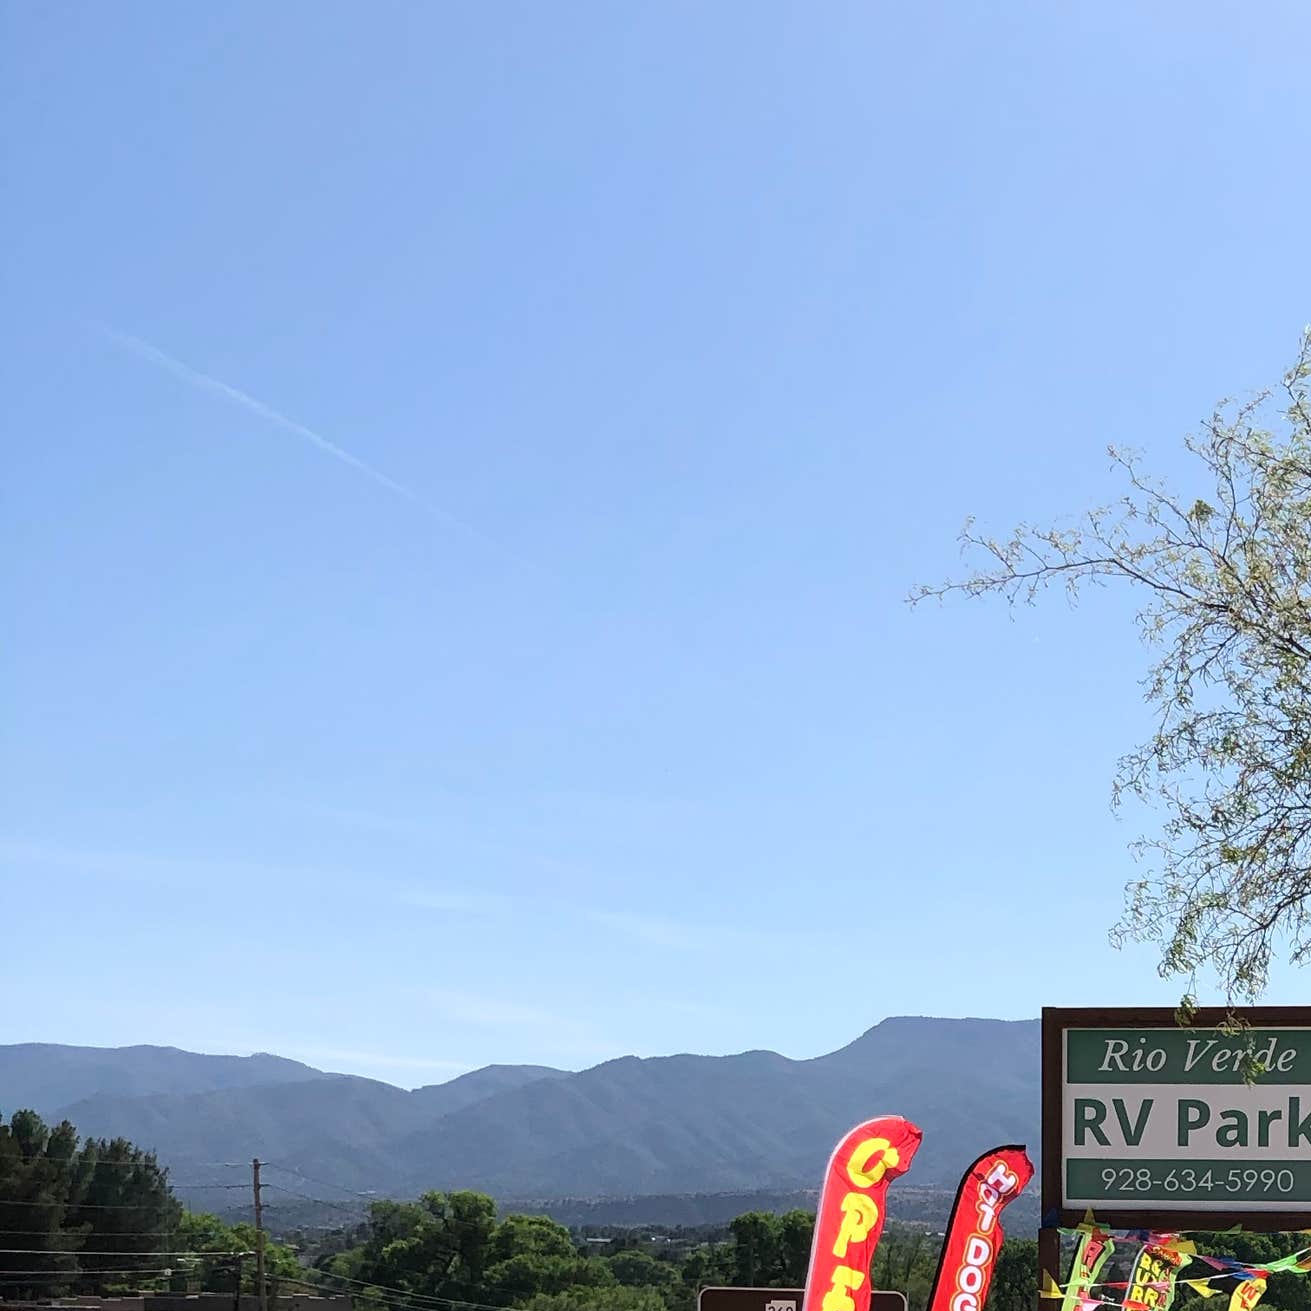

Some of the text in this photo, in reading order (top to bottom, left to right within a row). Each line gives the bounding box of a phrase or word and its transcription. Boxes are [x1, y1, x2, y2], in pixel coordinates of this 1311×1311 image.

[1098, 1036, 1297, 1073] Rio Verde
[1073, 1097, 1154, 1147] RV
[978, 1161, 1018, 1233] HOT
[1101, 1168, 1295, 1193] 928-634-5990
